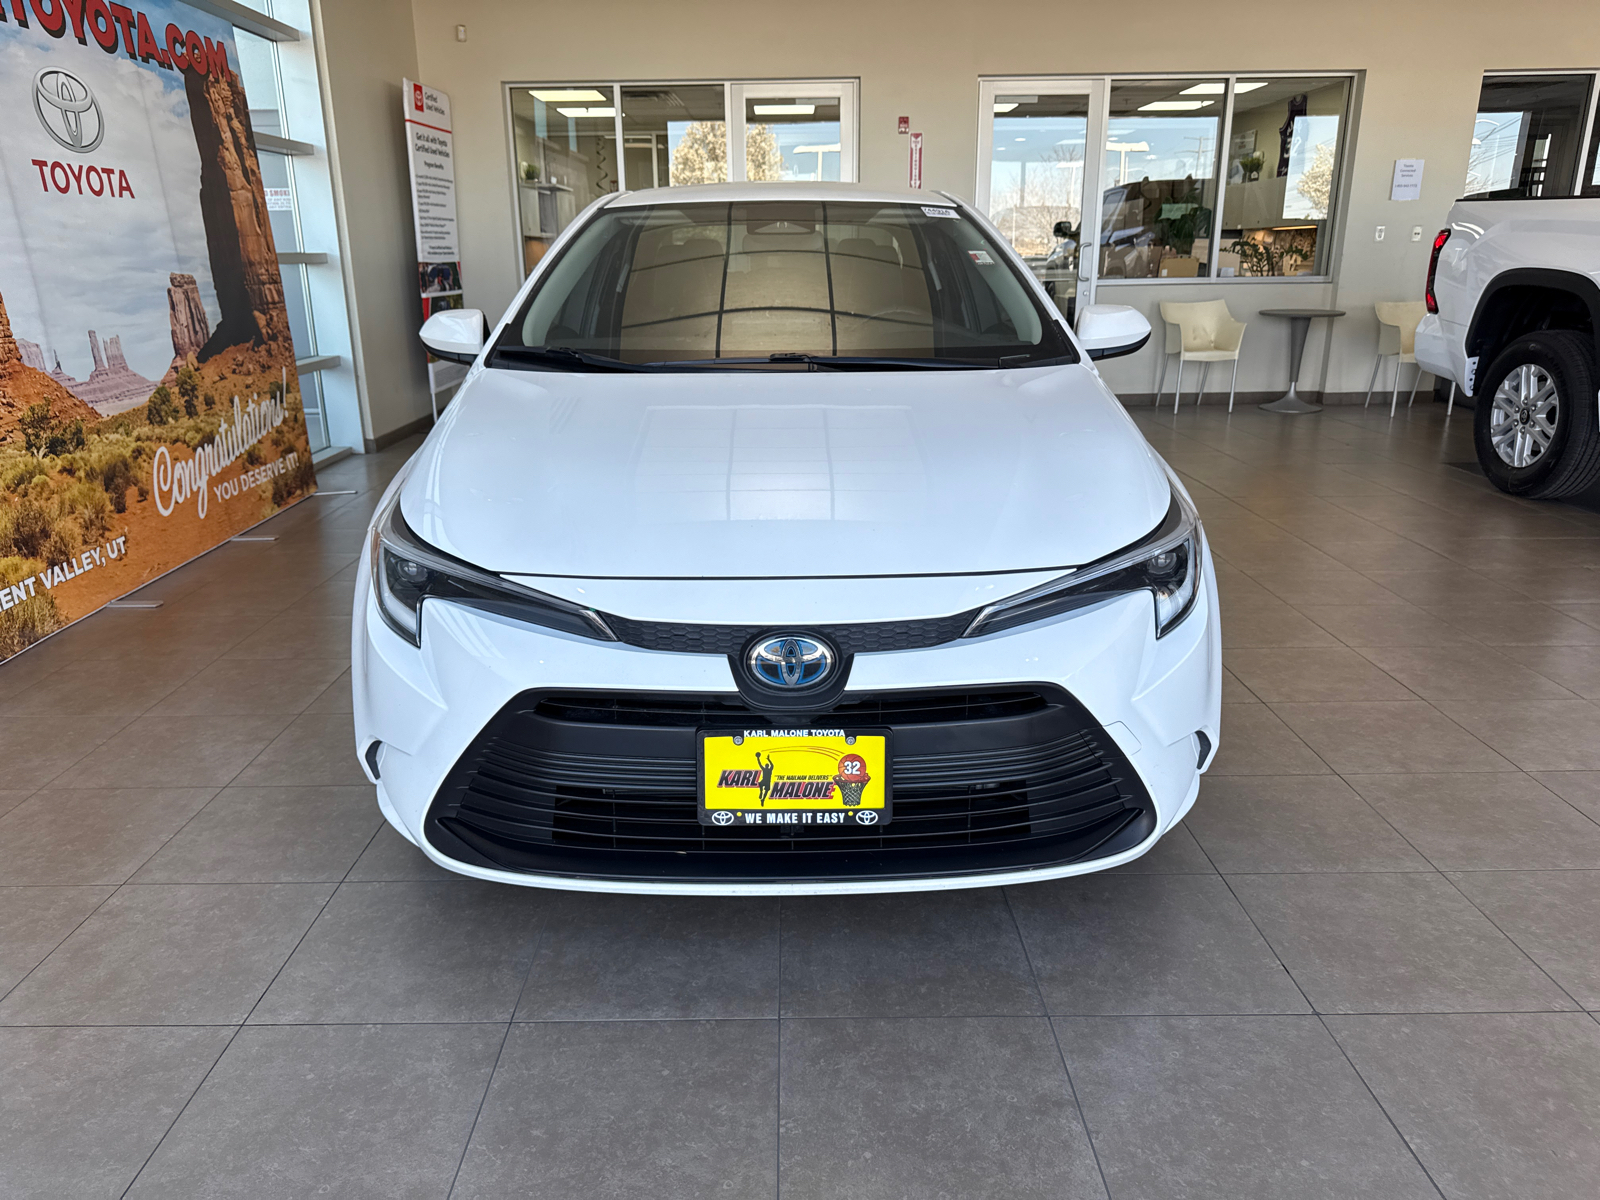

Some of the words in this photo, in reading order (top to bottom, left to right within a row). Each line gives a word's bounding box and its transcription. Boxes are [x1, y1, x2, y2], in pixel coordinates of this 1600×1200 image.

[31, 158, 135, 199] TOYOTA
[153, 366, 289, 519] Congratulations!
[213, 478, 239, 503] YOU
[240, 457, 286, 492] DESERVE
[286, 451, 299, 471] IT!
[0, 576, 36, 613] ENT
[39, 547, 106, 590] VALLEY,
[106, 535, 126, 559] UT
[743, 729, 769, 737] KARL
[770, 729, 808, 737] MALONE
[811, 729, 845, 737] TOYOTA
[844, 760, 861, 774] 32
[717, 769, 762, 788] KARL
[768, 781, 837, 799] MALONE
[745, 812, 762, 824] WE
[766, 812, 798, 824] MAKE
[802, 812, 812, 823] IT
[816, 812, 845, 823] EASY
